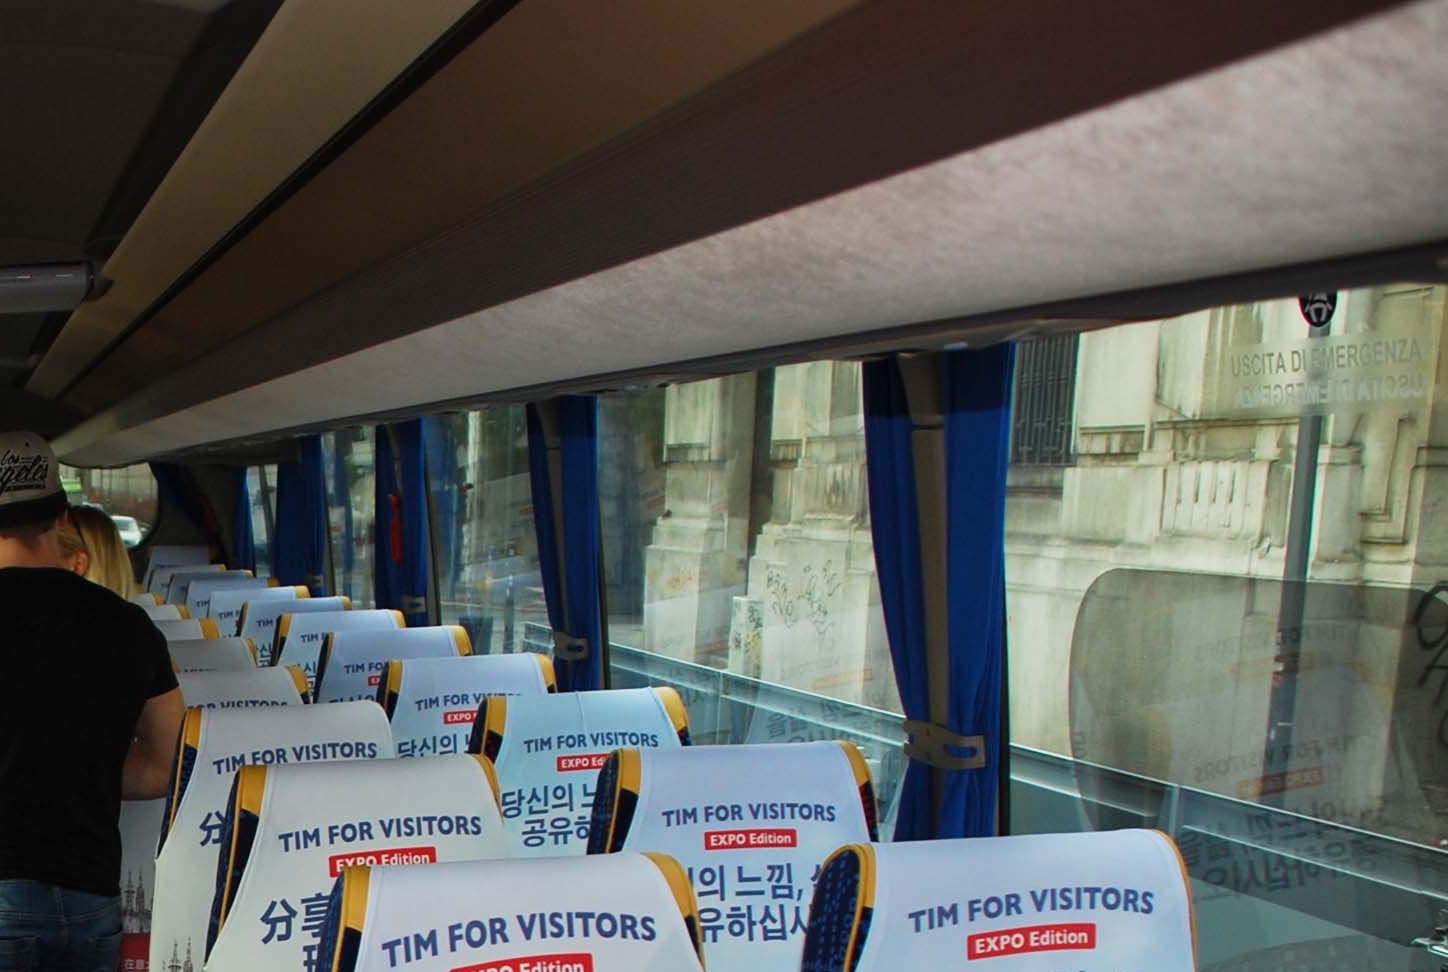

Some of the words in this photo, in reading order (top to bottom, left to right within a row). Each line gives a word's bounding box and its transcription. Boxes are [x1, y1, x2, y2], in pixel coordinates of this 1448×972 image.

[1231, 351, 1286, 376] USCITA
[1291, 350, 1307, 372] DI
[256, 619, 274, 628] TIM
[300, 634, 320, 643] TIM
[344, 664, 365, 674] TIM
[368, 662, 385, 672] FO
[415, 699, 440, 712] TIM
[443, 693, 470, 706] FOR
[447, 712, 472, 722] EXPO
[524, 736, 553, 753] TIM
[556, 734, 586, 750] FOR
[589, 731, 659, 748] VISITORS
[213, 754, 246, 775] TIM
[252, 749, 289, 766] FOR
[292, 742, 378, 762] VISITORS
[561, 757, 590, 769] EXPO
[501, 782, 575, 819] 당신의
[662, 807, 699, 827] TIM
[704, 804, 743, 823] FOR
[748, 802, 837, 822] VISITORS
[279, 827, 320, 852] TIM
[328, 821, 373, 845] FOR
[379, 815, 482, 840] VISITORS
[710, 833, 746, 847] EXPO
[749, 831, 792, 845] Edition
[335, 858, 378, 873] EXPO
[381, 852, 430, 867] Edition
[909, 903, 958, 934] TIM
[968, 895, 1023, 923] FOR
[1030, 886, 1154, 915] VISITORS
[382, 929, 439, 968] TIM
[449, 917, 509, 952] FOR
[517, 911, 657, 942] VISITORS
[975, 932, 1024, 954] EXPO
[1030, 928, 1089, 948] Edition
